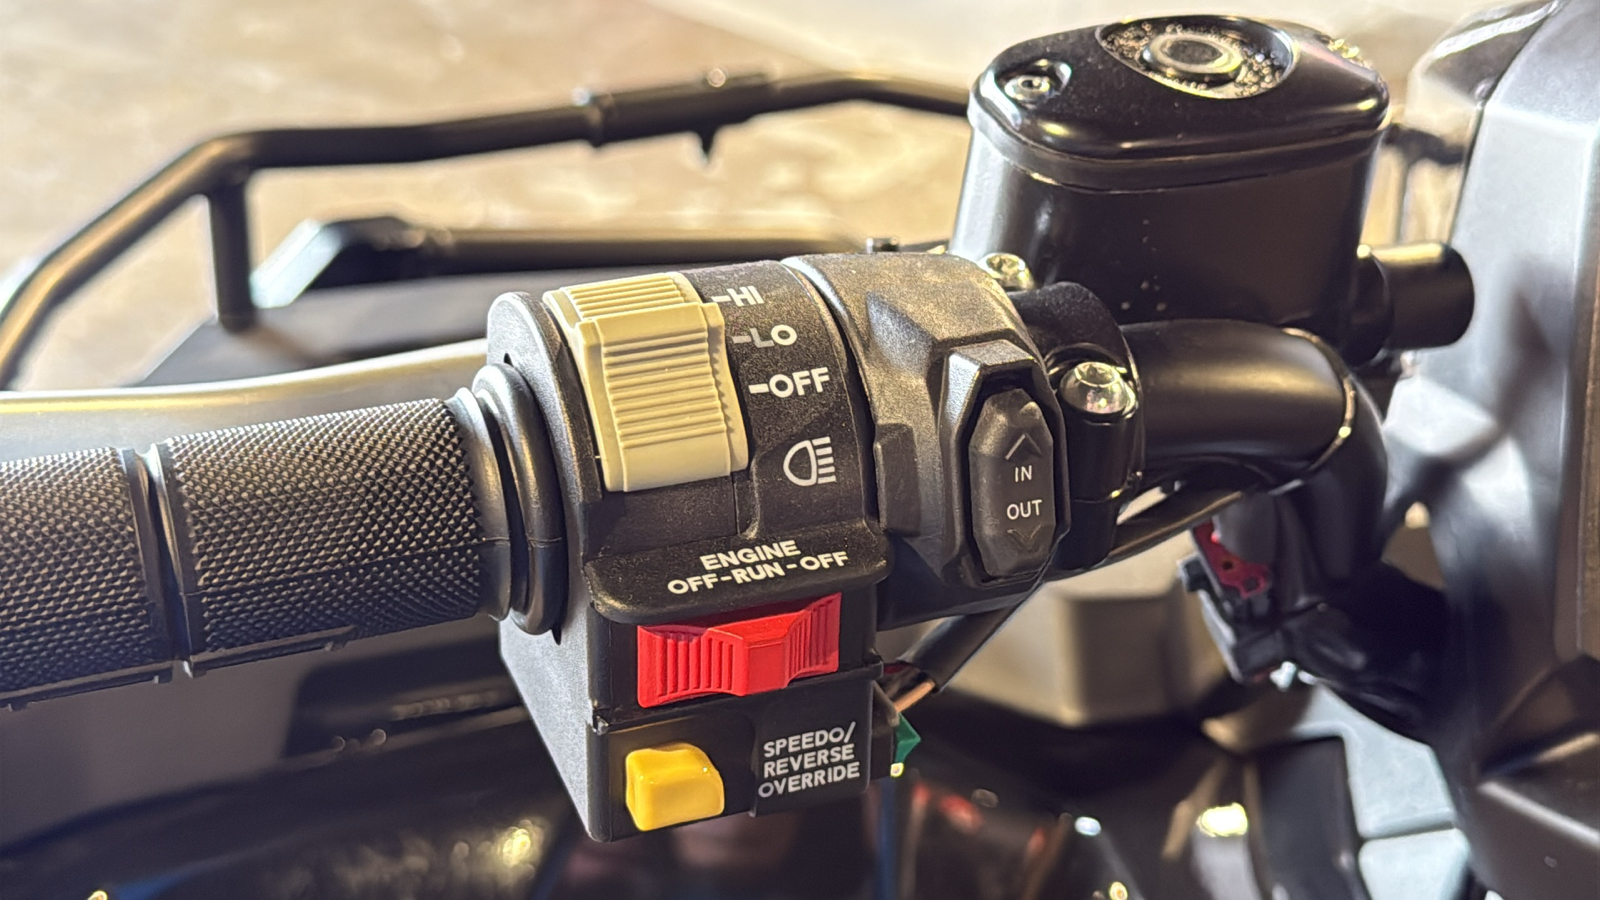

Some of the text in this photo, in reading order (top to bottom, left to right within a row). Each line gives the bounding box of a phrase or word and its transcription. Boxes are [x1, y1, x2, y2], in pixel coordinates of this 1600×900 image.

[1014, 465, 1033, 483] IN
[1006, 499, 1043, 520] OUT
[699, 540, 802, 571] ENGINE
[763, 721, 856, 758] SPEEDO/
[763, 744, 855, 778] REVERSE
[758, 762, 860, 798] OVERRIDE
